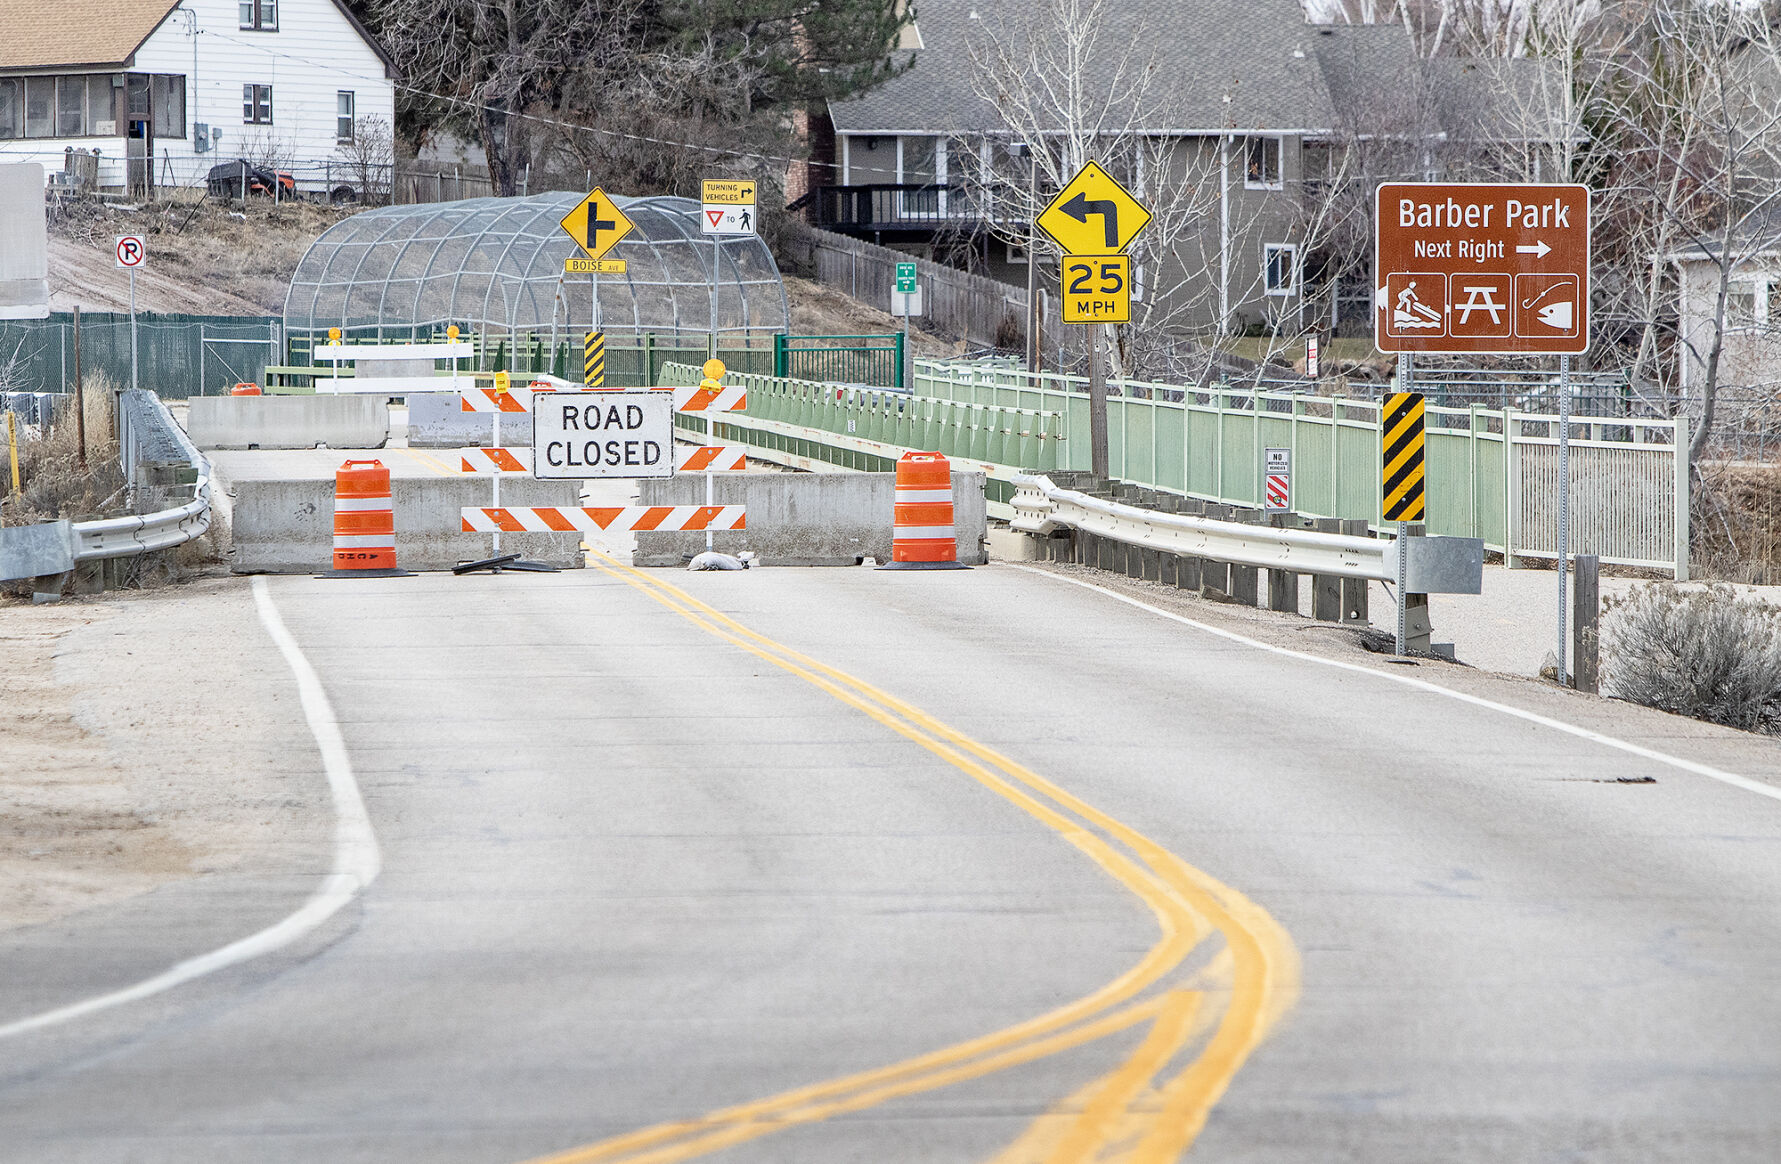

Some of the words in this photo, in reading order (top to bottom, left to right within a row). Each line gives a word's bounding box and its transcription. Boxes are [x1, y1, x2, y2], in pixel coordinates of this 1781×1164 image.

[1399, 197, 1494, 228] Barber
[1506, 198, 1571, 229] Park
[1414, 240, 1452, 258] Next
[1458, 239, 1505, 263] Right
[572, 260, 603, 271] BOISE
[1069, 263, 1123, 294] 25
[1077, 300, 1115, 314] MPH
[562, 405, 644, 430] ROAD
[546, 440, 661, 467] CLOSED
